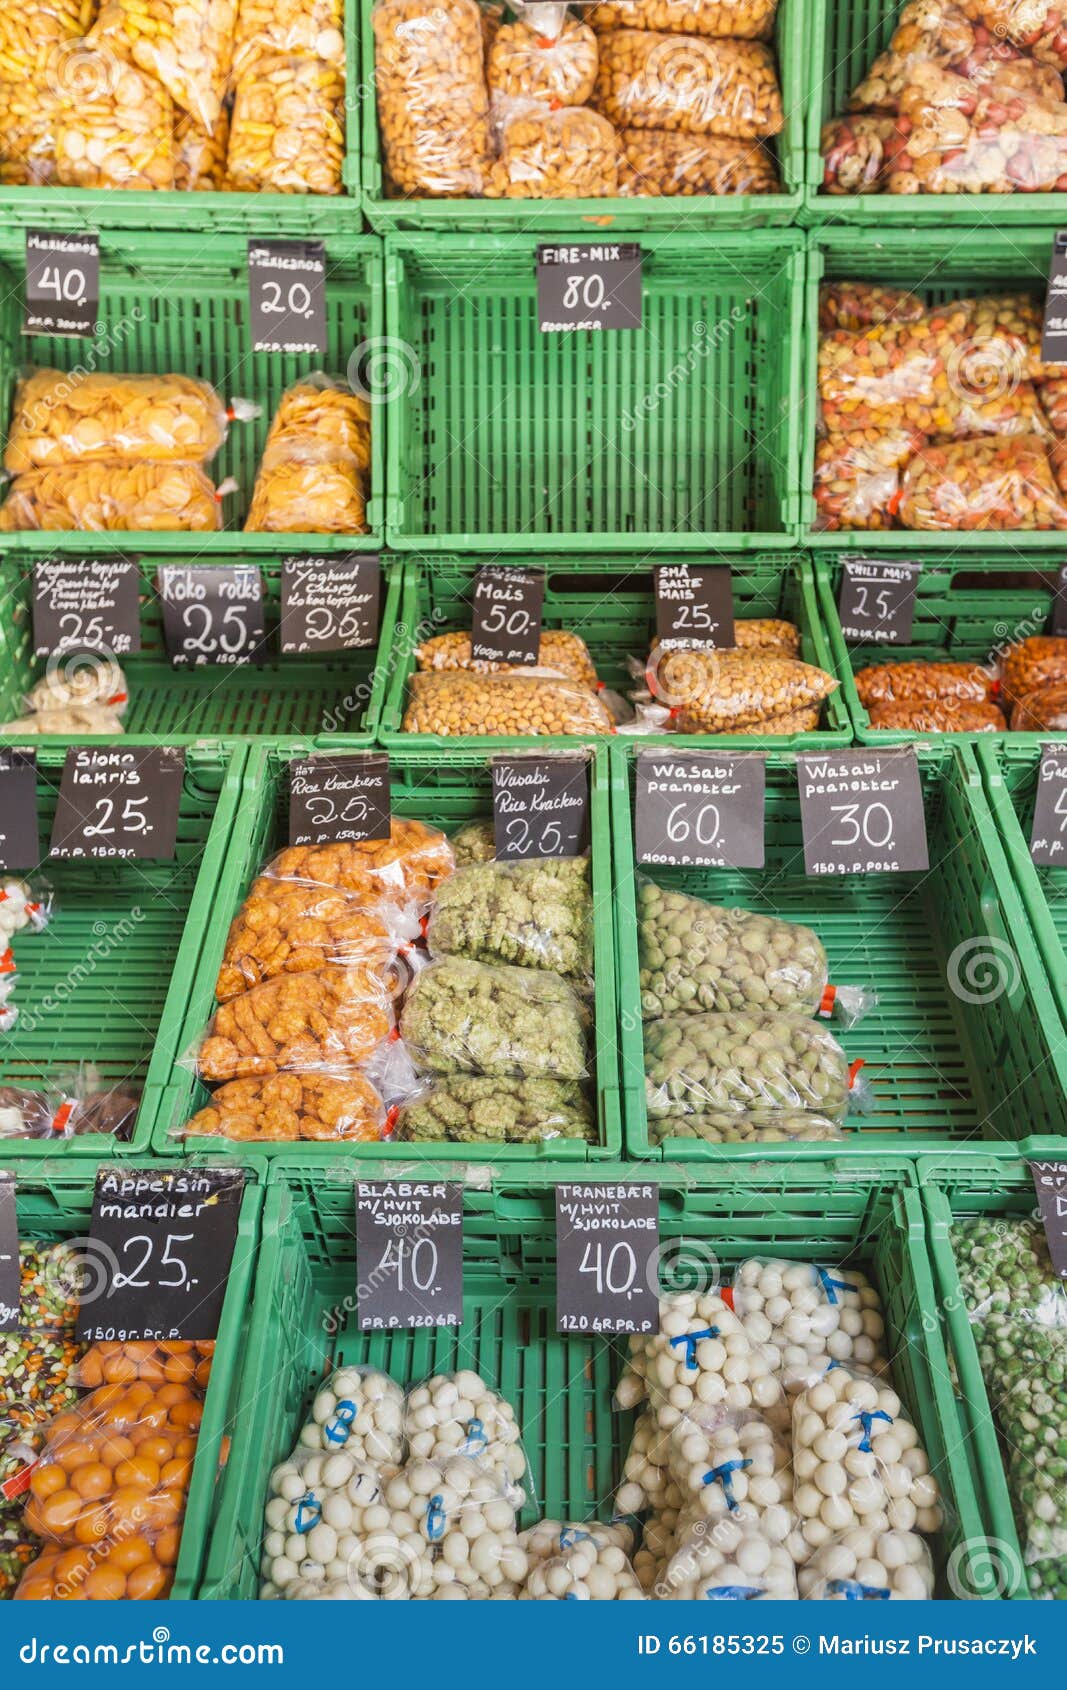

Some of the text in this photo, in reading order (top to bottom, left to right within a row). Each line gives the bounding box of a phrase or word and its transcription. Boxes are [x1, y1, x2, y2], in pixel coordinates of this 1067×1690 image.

[542, 246, 620, 264] FIRE-MIX
[658, 577, 703, 589] SALTE
[476, 583, 524, 600] Mais
[658, 589, 695, 600] MAIS
[73, 769, 140, 784] lakris
[495, 765, 550, 787] Wasabi
[653, 763, 734, 779] Wasabi
[805, 760, 880, 779] Wasabi
[291, 777, 320, 794] Rice
[495, 790, 527, 813] Rice
[101, 1174, 211, 1196] Appelsin
[358, 1183, 446, 1199] BLÅBÆR
[558, 1185, 653, 1199] TRANEBÆR
[374, 1213, 462, 1226] SJOKOLADE
[573, 1218, 657, 1231] SJOKOLADE
